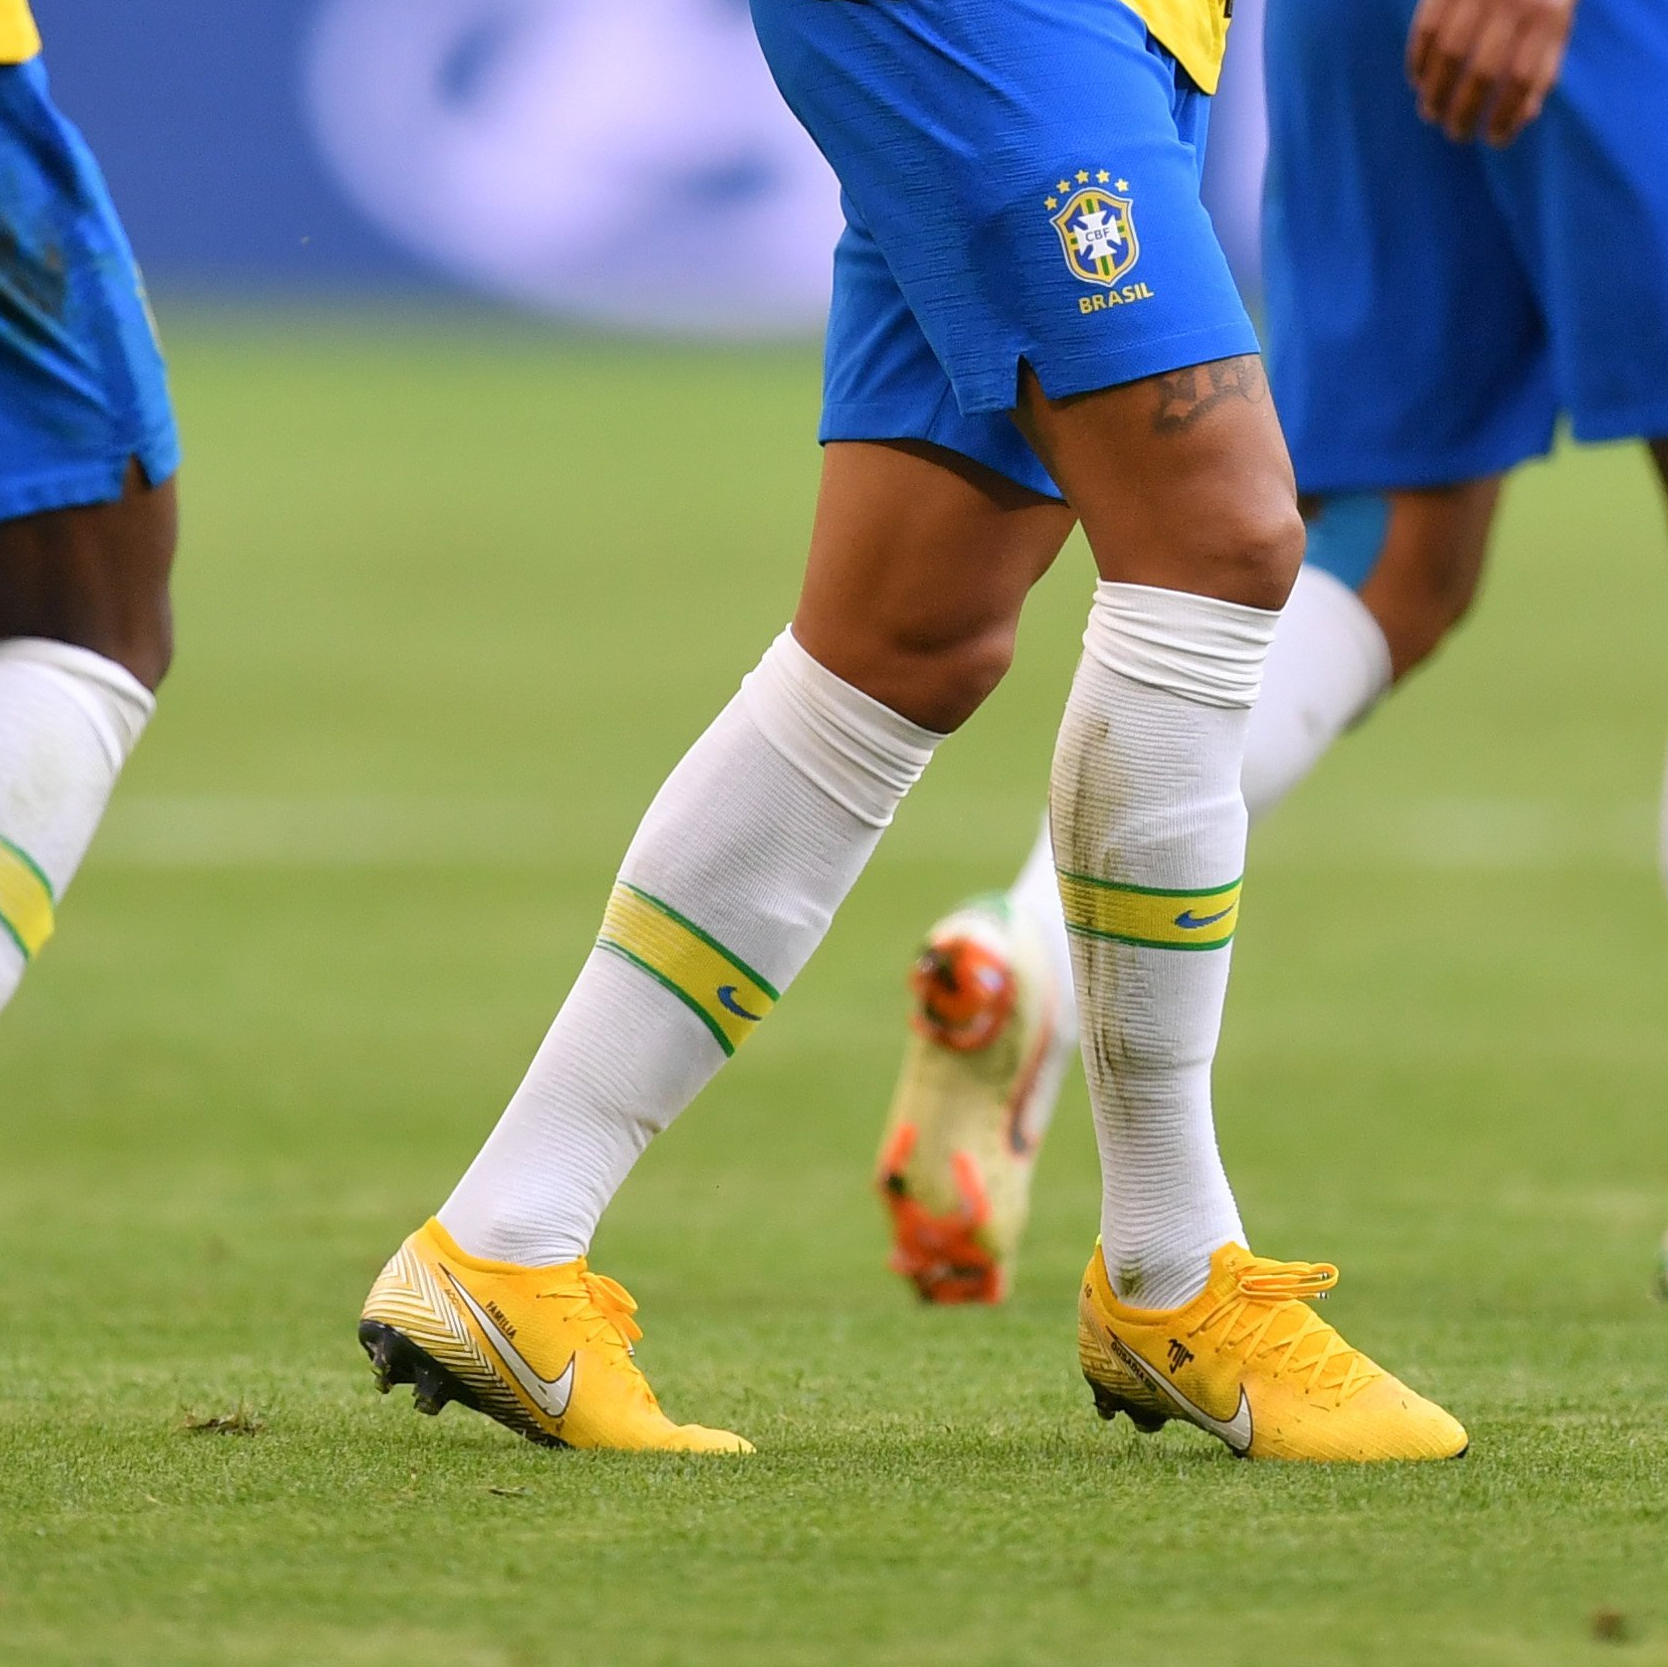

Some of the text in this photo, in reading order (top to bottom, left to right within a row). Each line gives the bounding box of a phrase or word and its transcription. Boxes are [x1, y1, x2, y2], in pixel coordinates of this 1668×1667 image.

[1085, 227, 1111, 243] CBF
[1078, 282, 1155, 315] BRASIL
[486, 1300, 518, 1340] FAMILIA
